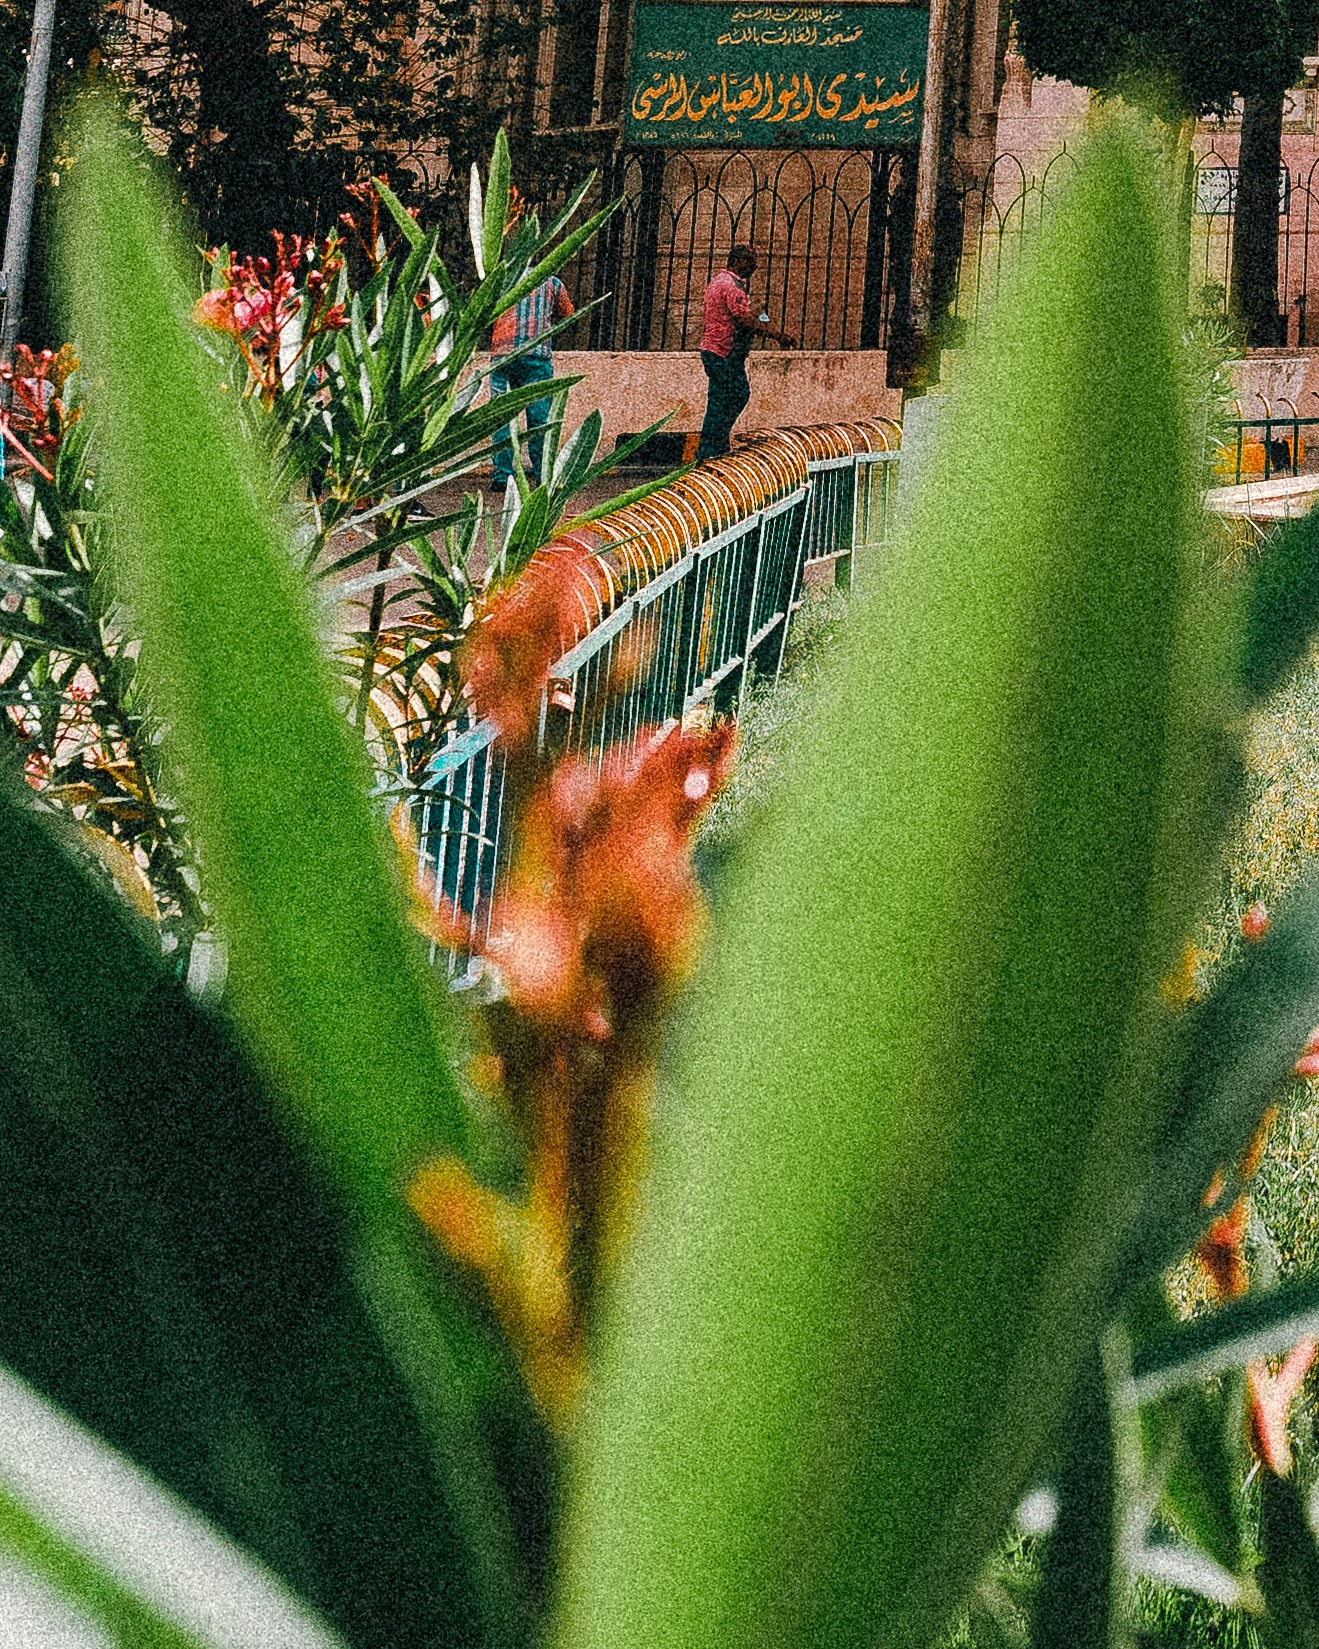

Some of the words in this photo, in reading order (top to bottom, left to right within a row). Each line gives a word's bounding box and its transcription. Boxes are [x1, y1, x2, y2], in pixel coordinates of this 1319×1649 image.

[716, 27, 760, 47] بالله
[761, 26, 818, 46] العارف
[820, 25, 864, 47] مسجد
[687, 71, 773, 123] العباس
